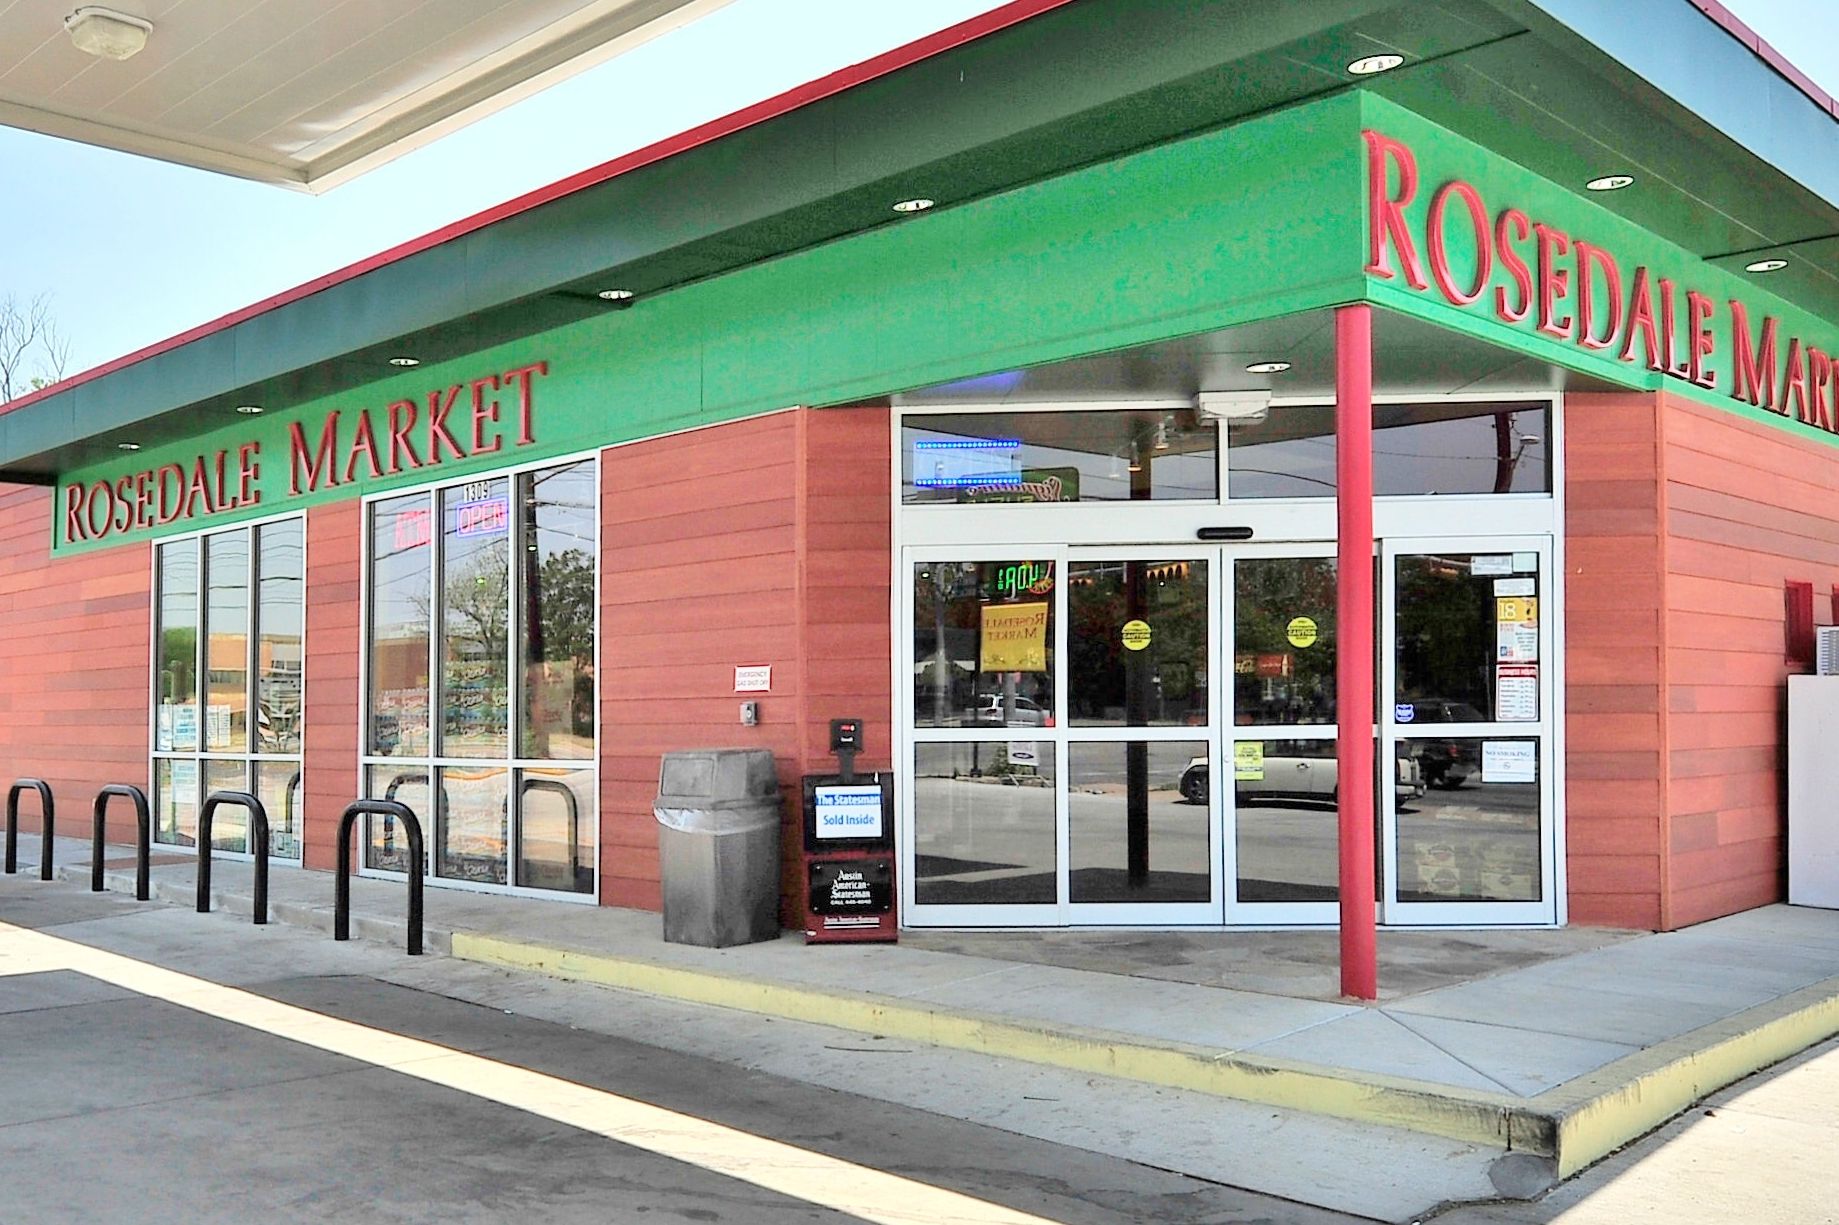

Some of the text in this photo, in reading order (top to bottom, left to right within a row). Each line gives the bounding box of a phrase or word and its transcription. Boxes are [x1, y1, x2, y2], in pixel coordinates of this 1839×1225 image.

[1362, 129, 1716, 389] ROSEDALE
[65, 361, 548, 543] ROSEDALE MARKET
[465, 481, 488, 501] 1309
[459, 502, 505, 534] OPEN
[816, 794, 880, 805] The Statesman
[823, 815, 875, 825] Sold Inside
[837, 869, 863, 880] Austin
[830, 890, 871, 899] Statesman
